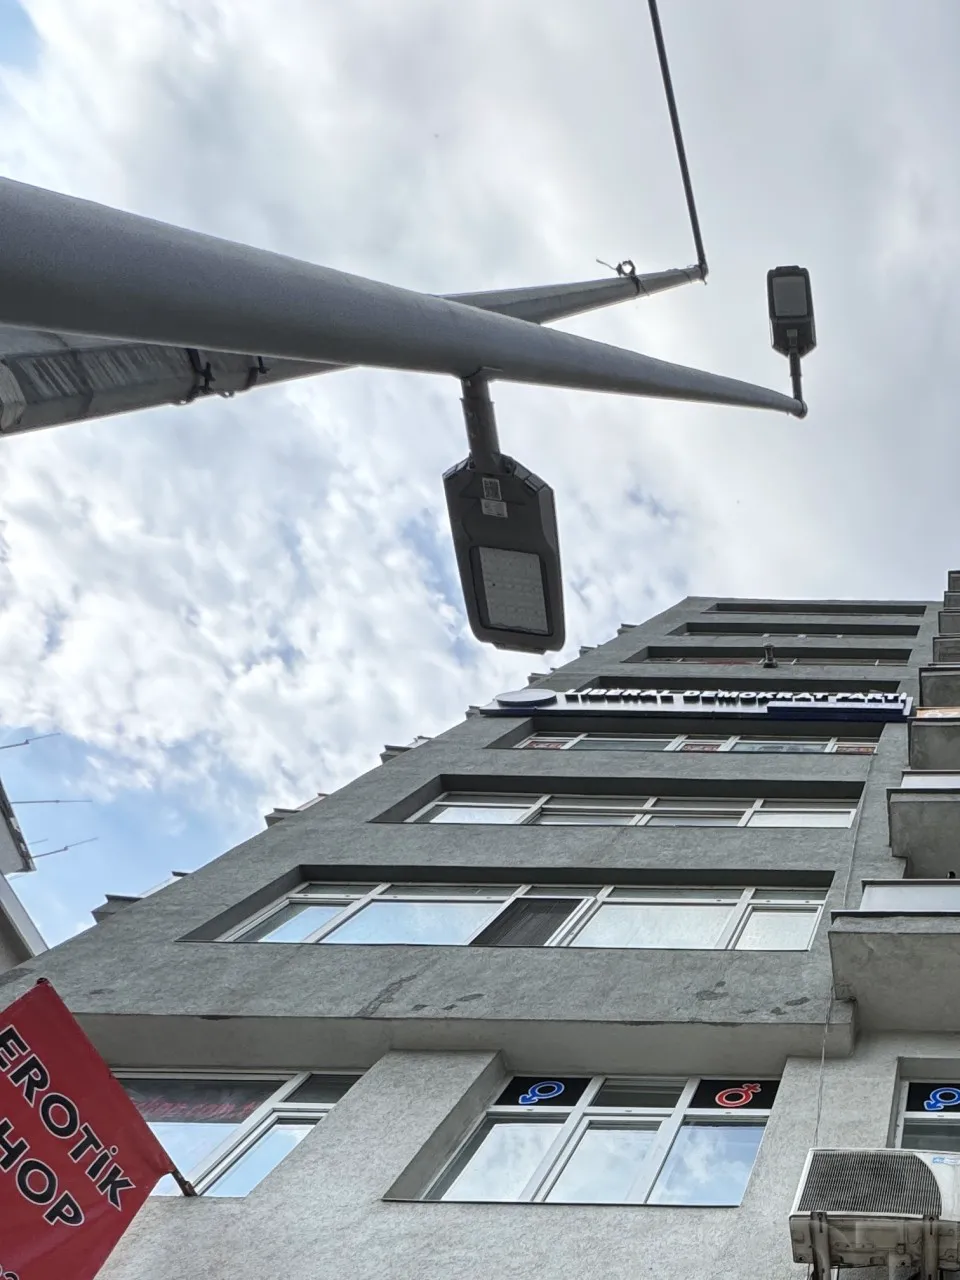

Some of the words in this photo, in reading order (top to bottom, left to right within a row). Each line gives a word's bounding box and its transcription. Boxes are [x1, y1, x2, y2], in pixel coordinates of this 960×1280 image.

[683, 690, 829, 699] DEMOKRAT
[0, 1024, 137, 1212] EROTİK
[0, 1117, 85, 1227] HOP
